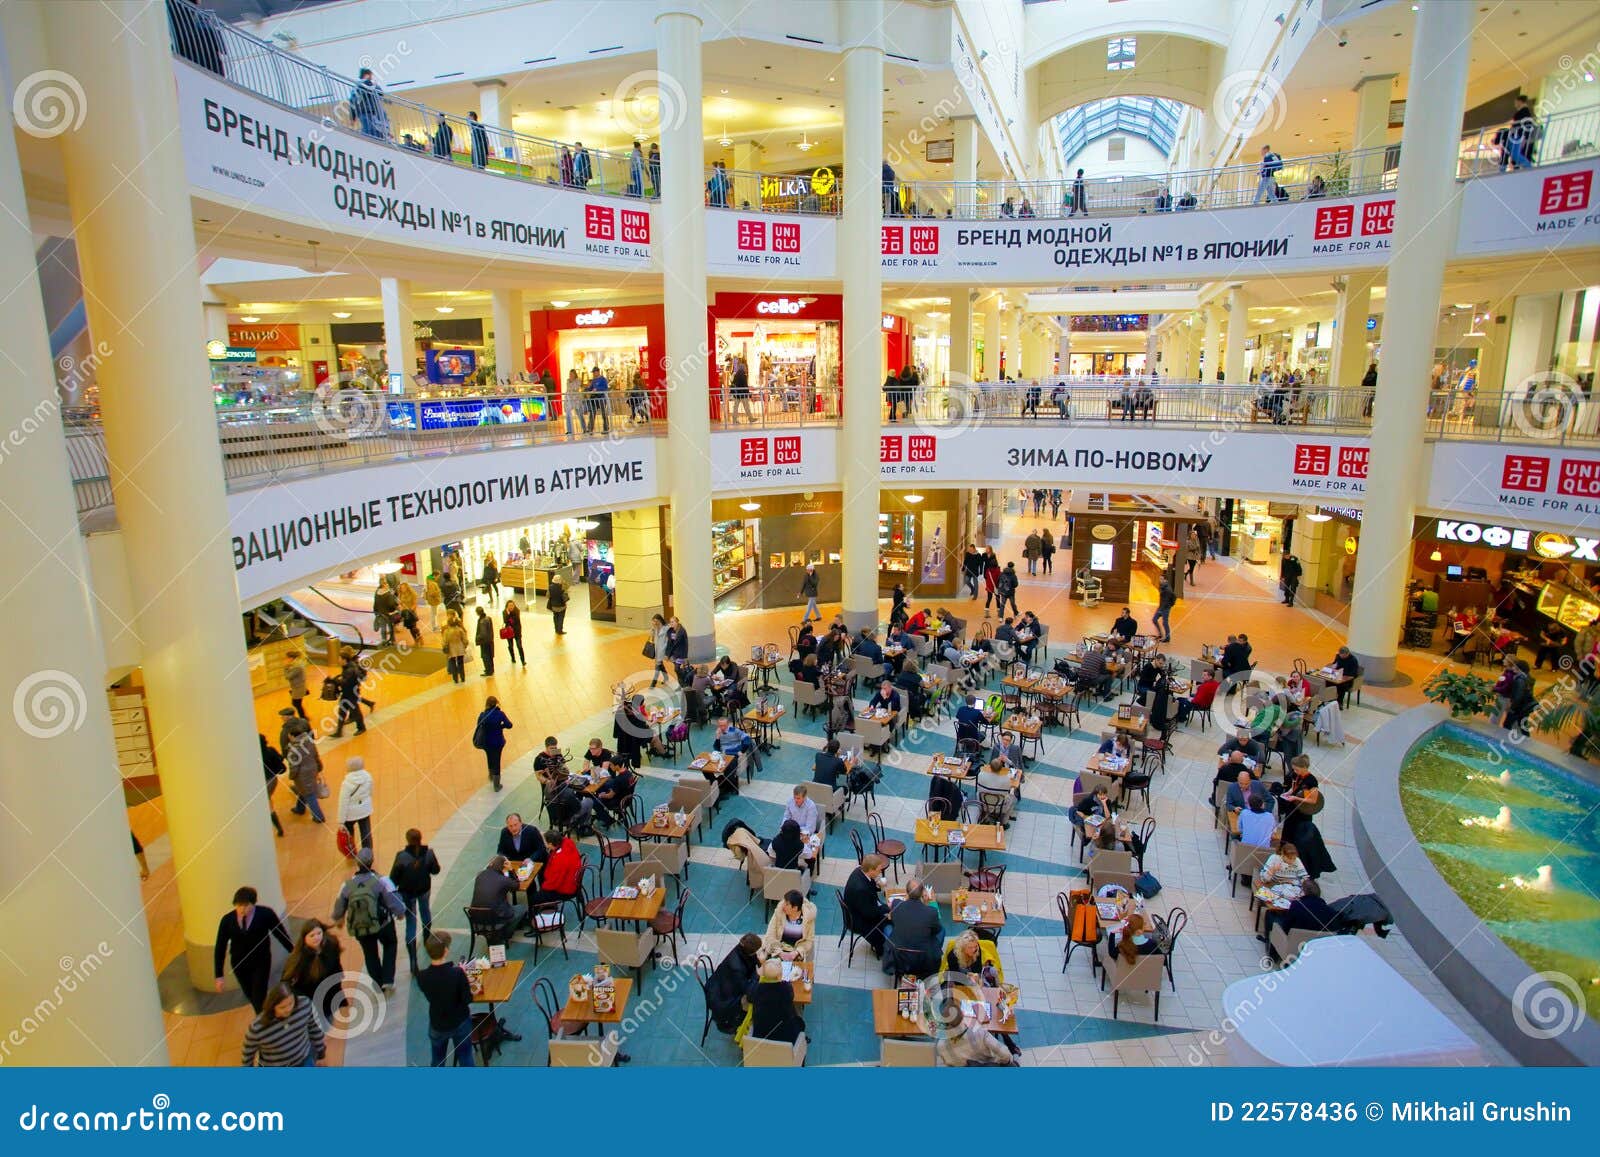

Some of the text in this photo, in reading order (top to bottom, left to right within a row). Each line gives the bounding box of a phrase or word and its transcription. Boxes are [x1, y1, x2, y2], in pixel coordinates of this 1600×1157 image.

[204, 98, 395, 190] БРЕНД МОДНОЙ
[334, 185, 435, 230] ОДЕЖДЫ
[491, 220, 565, 249] ЯПОНИИ
[624, 214, 644, 227] UNI
[1536, 218, 1576, 231] MADE
[625, 227, 647, 240] QLO
[775, 226, 796, 237] UNI
[913, 229, 934, 240] UNI
[957, 223, 1112, 248] БРЕНД МОДНОЙ
[586, 244, 650, 258] MADE FOR ALL
[775, 239, 798, 250] QLO
[914, 242, 935, 252] QLO
[1313, 240, 1391, 253] MADE FOR AL
[1054, 246, 1146, 267] ОДЕЖДЫ
[1203, 238, 1288, 260] ЯПОНИИ
[737, 255, 800, 265] MADE FOR ALL
[777, 439, 797, 450] UNI
[912, 438, 932, 448] UNI
[777, 451, 799, 461] QLO
[911, 449, 933, 459] QLO
[1007, 448, 1213, 472] ЗИМА ПО-НОВОМУ
[741, 469, 763, 478] MADE
[919, 465, 935, 473] ALL
[1292, 479, 1366, 491] MADE FOR AL
[1499, 495, 1535, 507] MADE
[1543, 499, 1568, 511] FOR
[232, 461, 643, 570] ВАЦИОННЫЕ ТЕХНОЛОГИИ в АТРИУМЕ
[1436, 520, 1531, 551] КОФЕ
